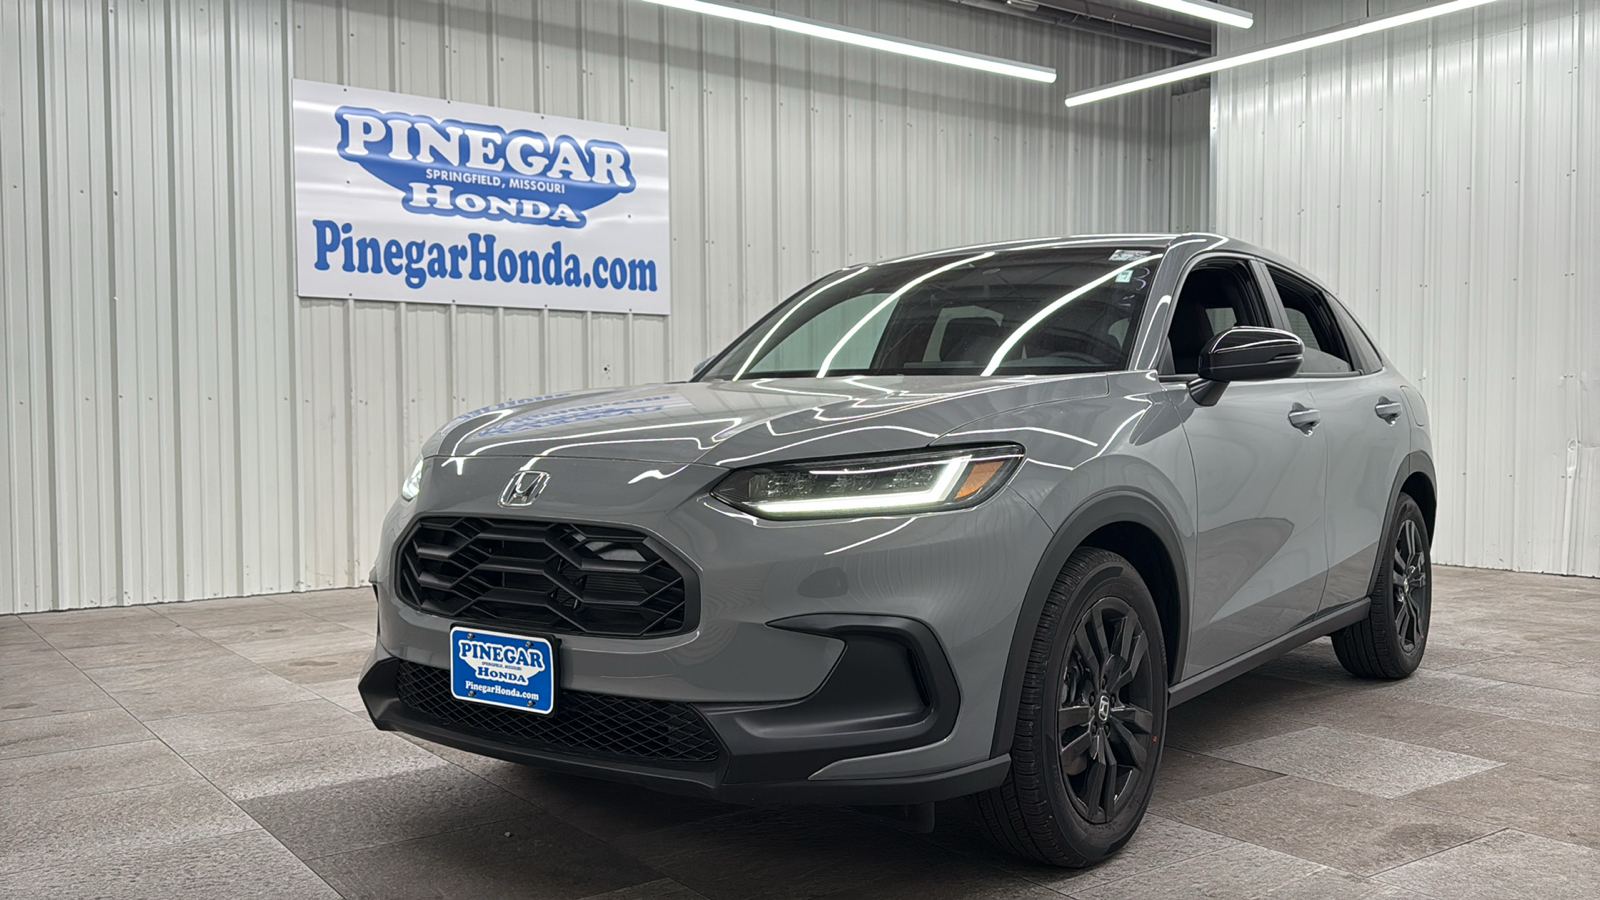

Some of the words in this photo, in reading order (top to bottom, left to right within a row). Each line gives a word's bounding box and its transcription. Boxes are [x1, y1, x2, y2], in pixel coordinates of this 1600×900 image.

[341, 113, 633, 188] PINEGAR
[425, 168, 507, 189] SPRINGFIELD,
[508, 178, 566, 195] MISSOURI
[406, 182, 581, 223] HONDA
[312, 219, 658, 292] PinegarHonda.com
[460, 642, 543, 668] PINEGAR
[477, 666, 527, 682] HONDA
[465, 680, 539, 700] PinegarHonda.com
